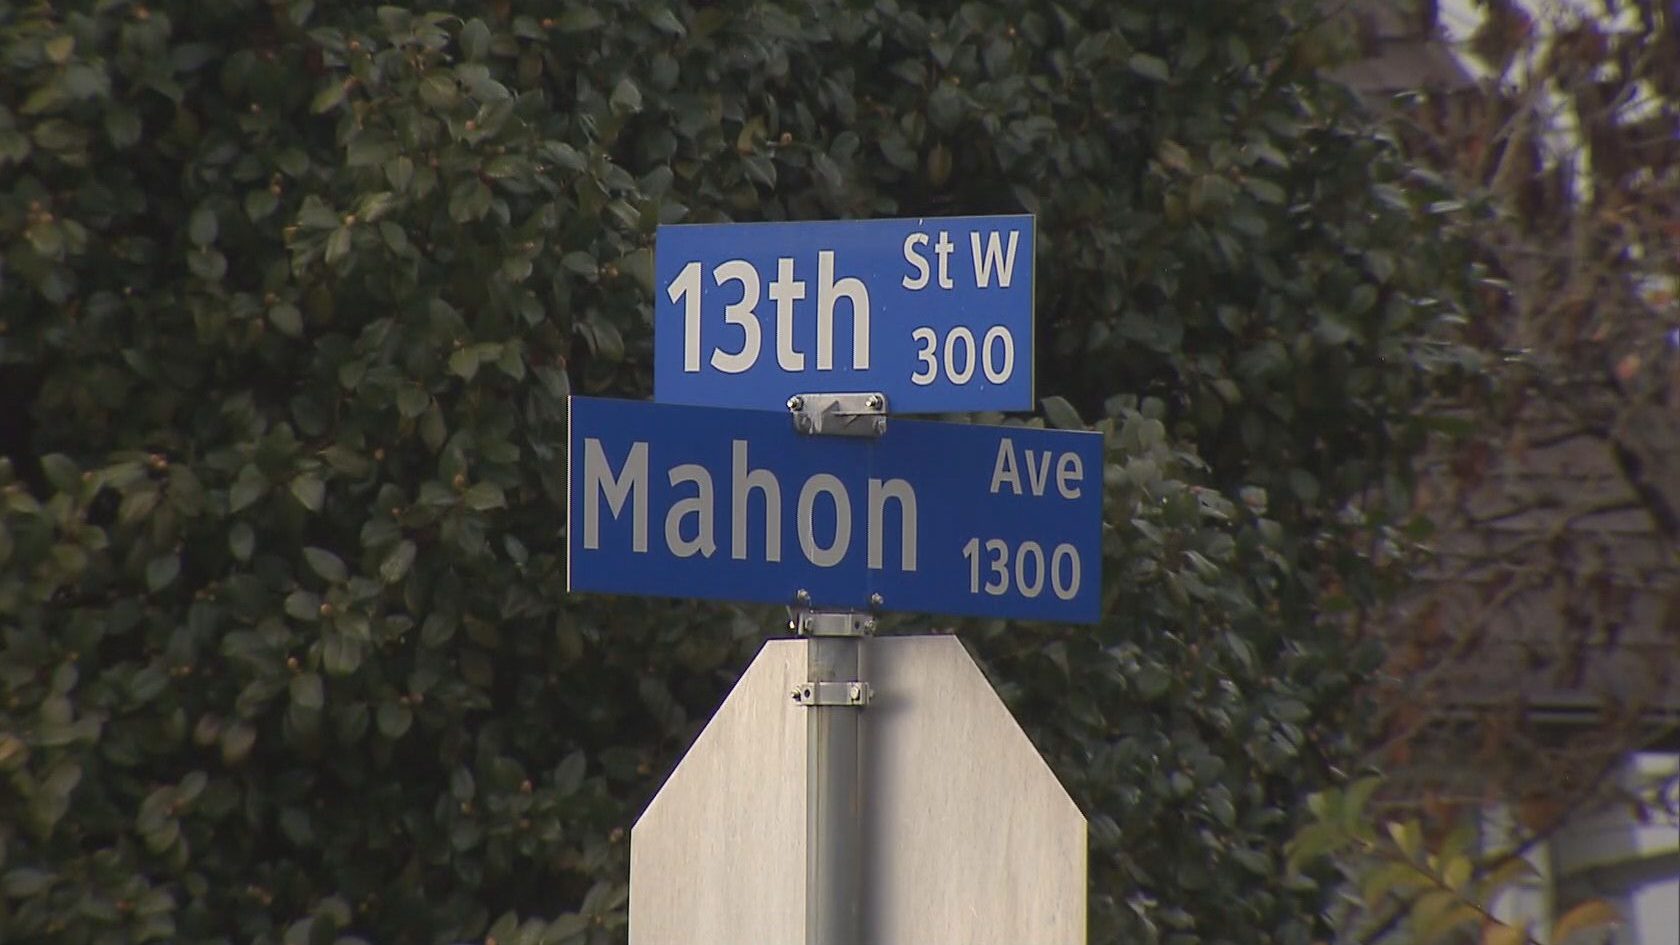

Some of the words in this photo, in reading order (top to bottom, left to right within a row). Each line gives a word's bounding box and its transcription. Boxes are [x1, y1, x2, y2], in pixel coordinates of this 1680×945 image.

[902, 231, 955, 290] St
[970, 230, 1020, 288] W
[666, 250, 870, 374] 13th
[911, 326, 1015, 386] 300
[990, 438, 1084, 499] Ave
[583, 438, 918, 572] Mahon
[962, 537, 1081, 600] 1300
